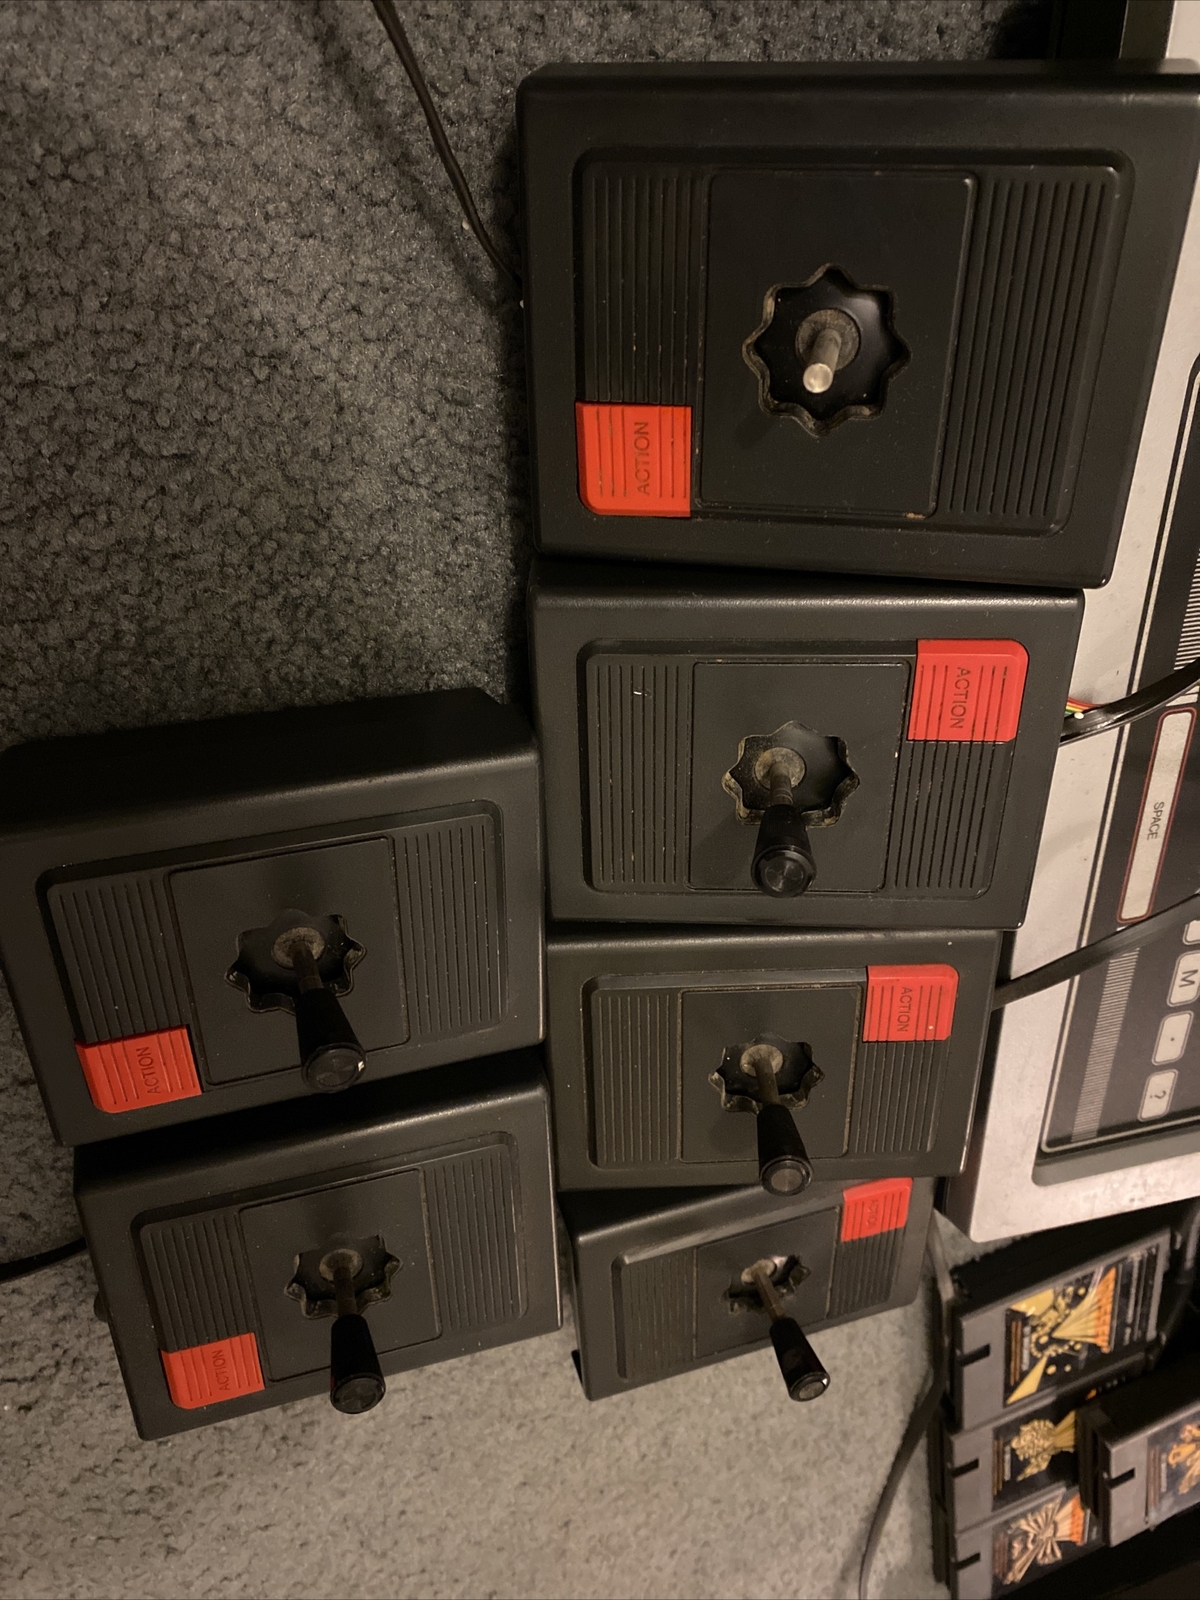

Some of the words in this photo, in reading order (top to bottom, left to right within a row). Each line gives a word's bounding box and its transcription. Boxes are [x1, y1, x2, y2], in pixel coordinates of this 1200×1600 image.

[634, 421, 650, 496] ACTION
[949, 666, 971, 729] ACTION
[1146, 801, 1165, 841] SPACE
[1178, 969, 1199, 988] M
[897, 986, 913, 1032] ACTION
[136, 1046, 161, 1094] ACTION
[1149, 1090, 1167, 1099] ?
[211, 1349, 231, 1391] ACTION
